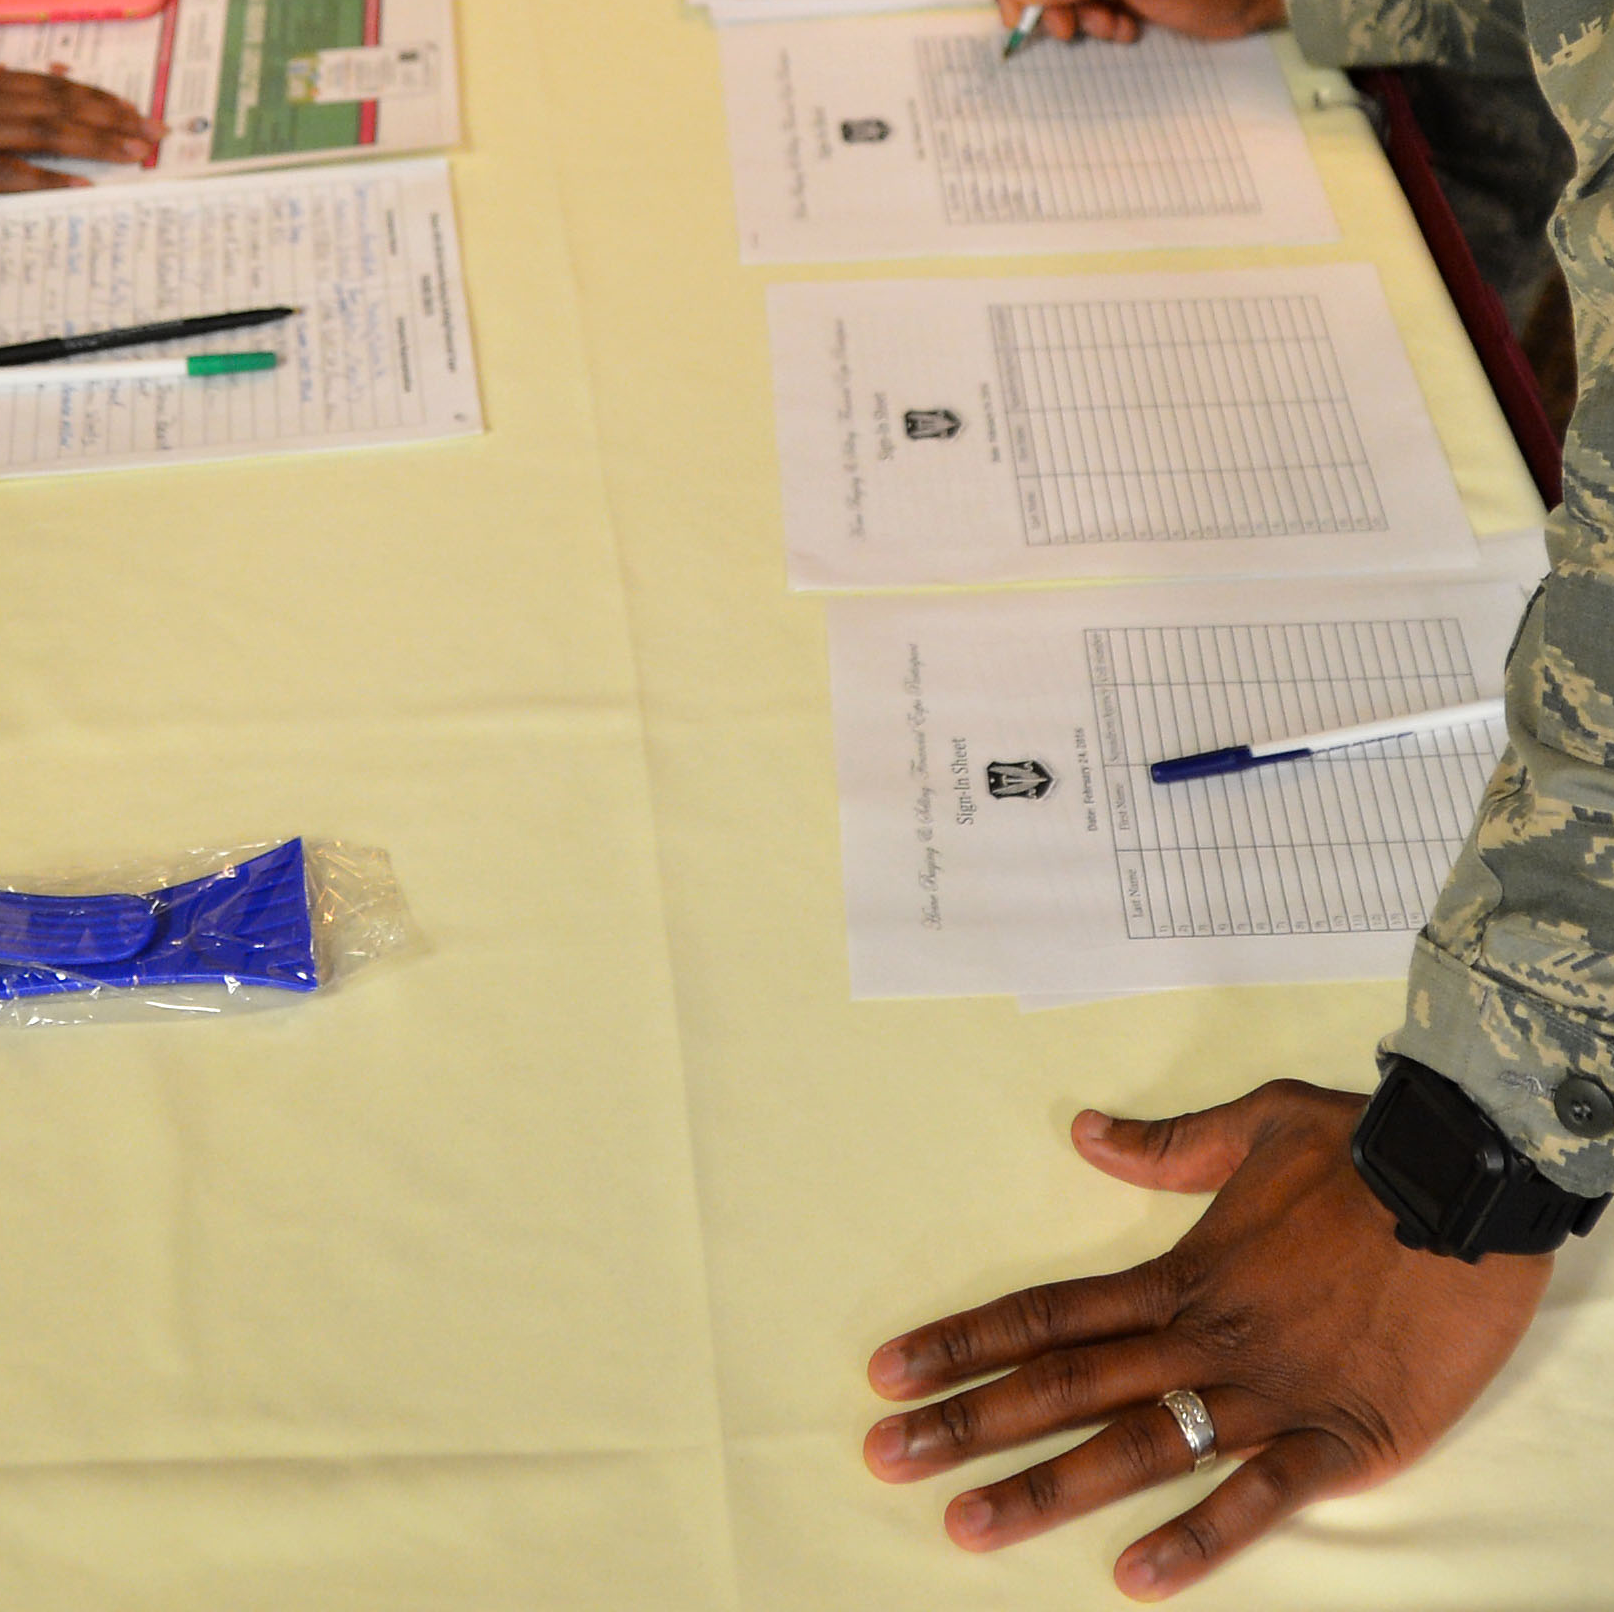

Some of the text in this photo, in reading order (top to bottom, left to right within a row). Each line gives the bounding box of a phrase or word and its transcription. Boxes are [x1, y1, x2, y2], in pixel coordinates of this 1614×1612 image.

[949, 737, 977, 825] Sign-In Sheet
[1081, 767, 1096, 805] February
[1086, 809, 1098, 832] Date:
[1115, 783, 1131, 831] First Name
[1127, 868, 1144, 919] Last Name
